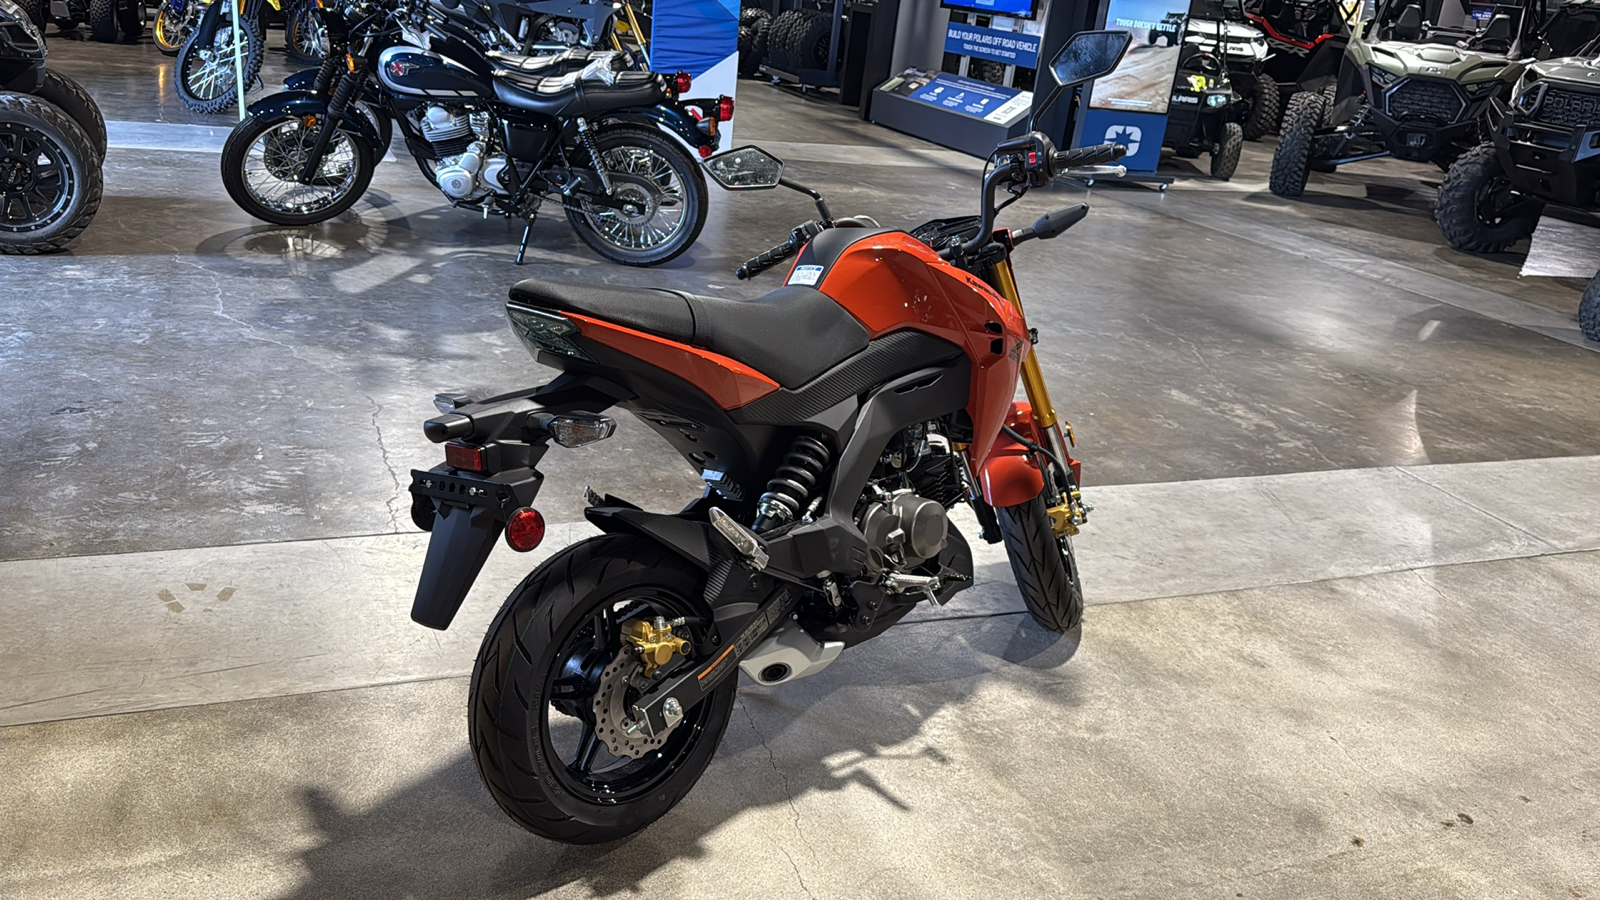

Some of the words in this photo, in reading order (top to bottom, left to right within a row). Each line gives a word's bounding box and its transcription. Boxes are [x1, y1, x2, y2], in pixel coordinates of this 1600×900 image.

[1116, 18, 1133, 27] TOUGH
[948, 29, 961, 39] BUILD
[961, 31, 973, 42] YOUR
[973, 33, 992, 45] POLARIS
[992, 37, 1002, 46] OFF
[1002, 38, 1016, 49] ROAD
[1016, 41, 1038, 53] VEHICLE
[1172, 94, 1198, 104] LARIS
